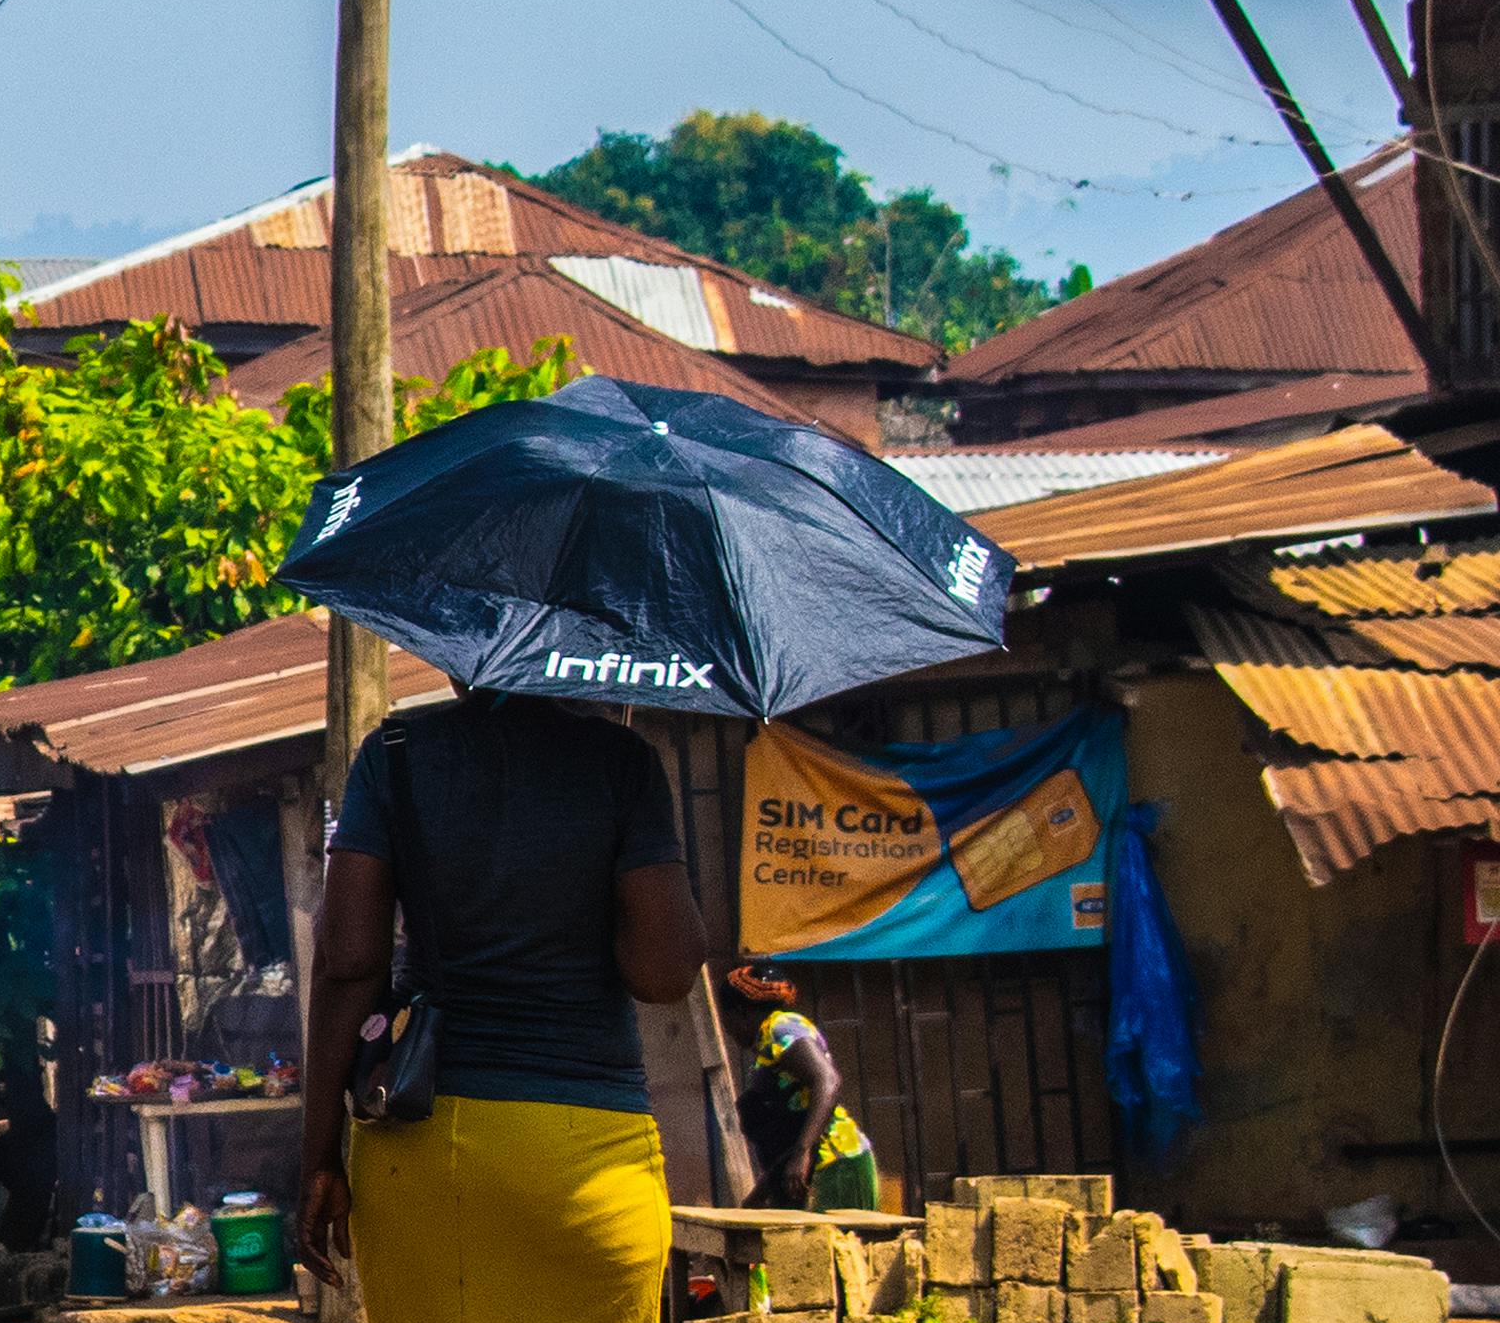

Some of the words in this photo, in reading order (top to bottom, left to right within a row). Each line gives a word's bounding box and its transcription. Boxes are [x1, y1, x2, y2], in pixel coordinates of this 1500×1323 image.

[544, 651, 714, 689] Infinix
[757, 798, 825, 829] SIM
[835, 804, 923, 835] Card
[755, 831, 925, 860] Registration
[753, 862, 850, 887] Center
